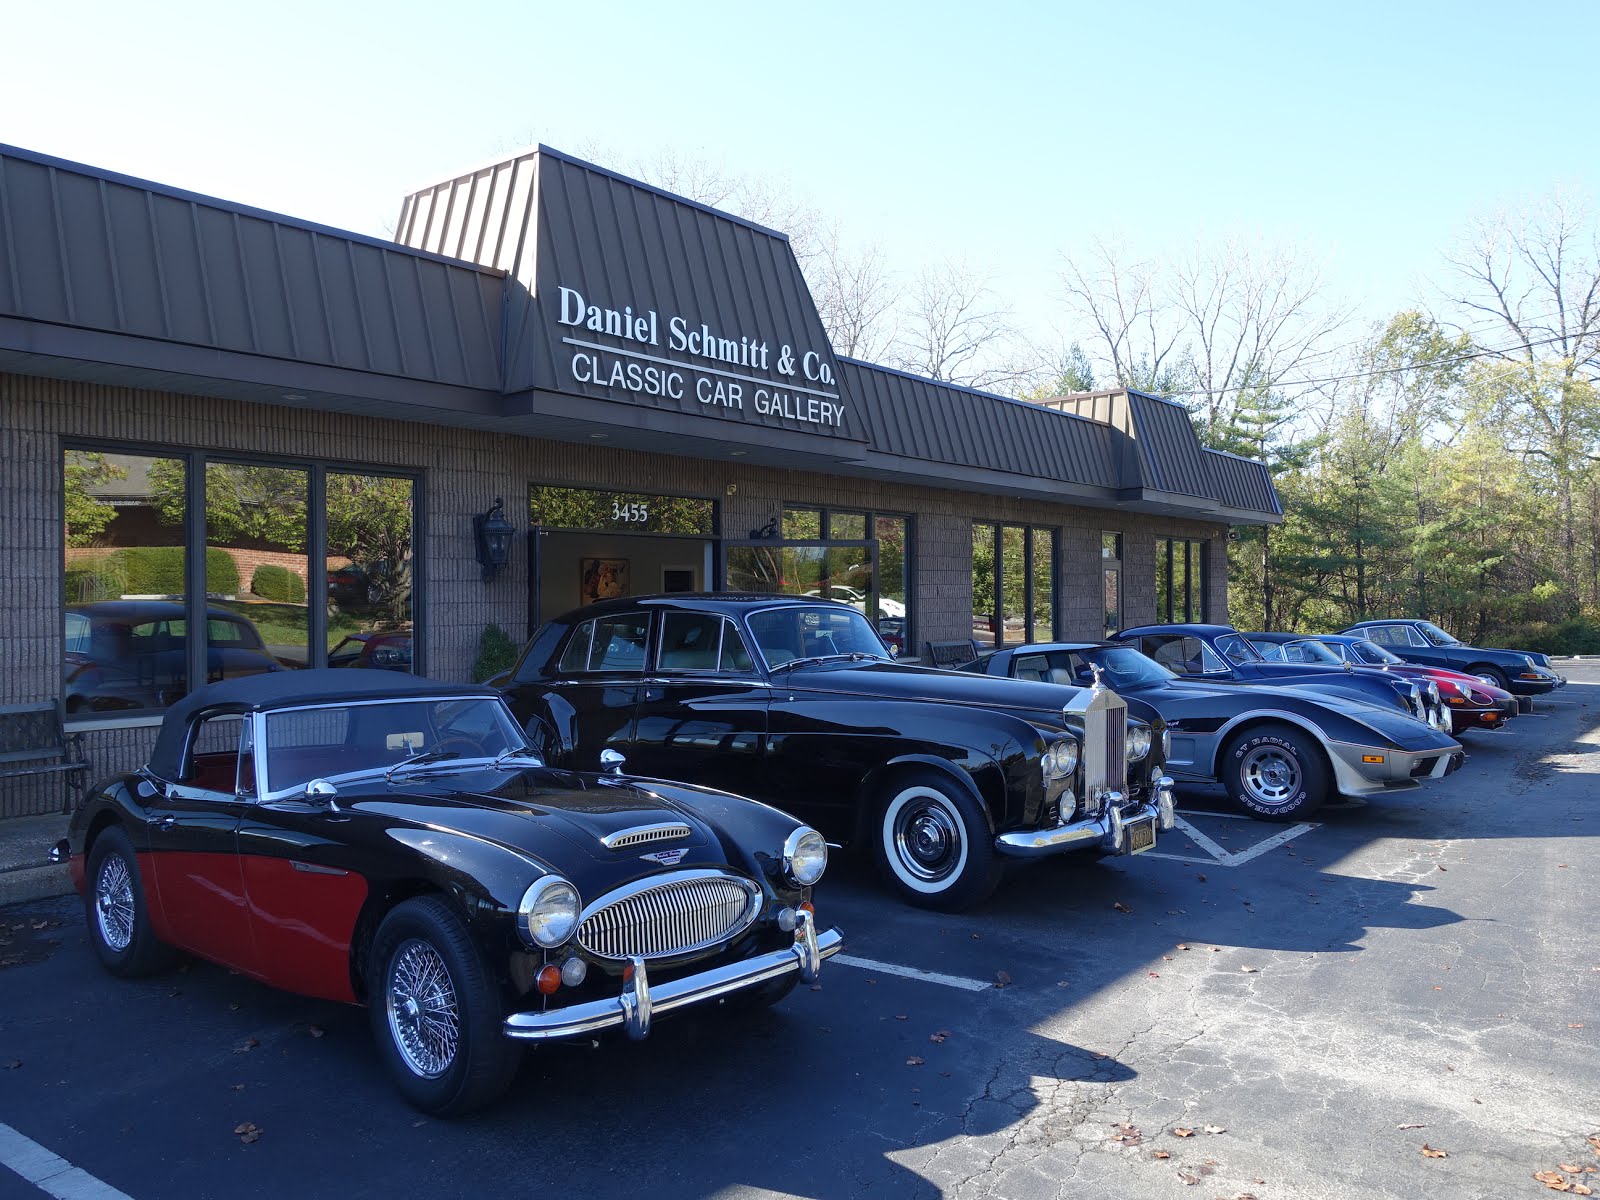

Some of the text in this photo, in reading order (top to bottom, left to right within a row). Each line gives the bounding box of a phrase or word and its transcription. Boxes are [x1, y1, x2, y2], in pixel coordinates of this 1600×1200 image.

[557, 286, 836, 386] Daniel Schmitt & Co.
[572, 353, 845, 427] CLASSIC CAR GALLERY
[611, 502, 648, 522] 3455
[1235, 736, 1297, 758] GT RADIAL
[1239, 791, 1307, 815] GOODYEAR
